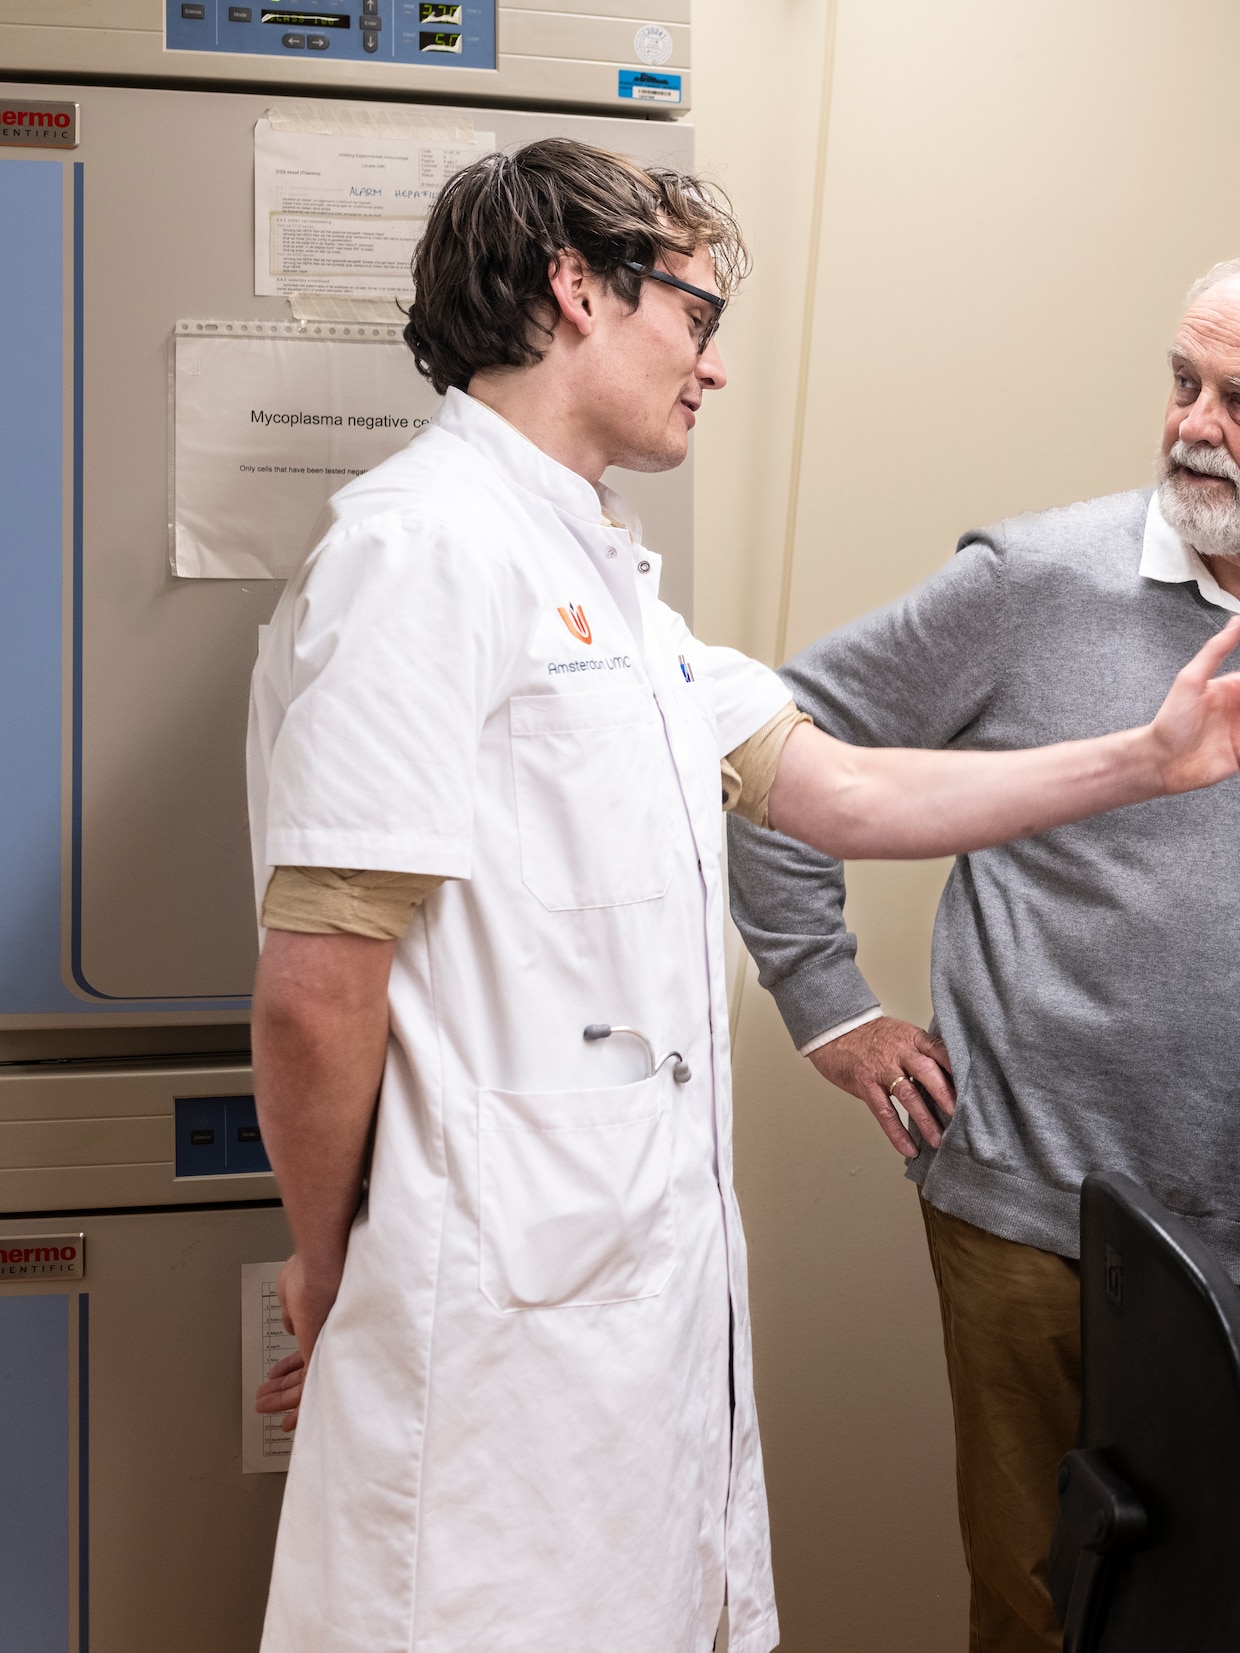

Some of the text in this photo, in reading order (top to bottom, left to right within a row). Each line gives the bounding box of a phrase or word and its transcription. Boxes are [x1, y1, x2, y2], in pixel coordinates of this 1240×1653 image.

[0, 110, 71, 128] ermo
[349, 186, 382, 196] ALARM
[250, 410, 433, 430] Mycoplasma negative ce
[239, 465, 256, 473] Only
[347, 468, 369, 476] negat
[604, 655, 632, 671] UMC
[1, 1263, 75, 1274] IENTIFIC
